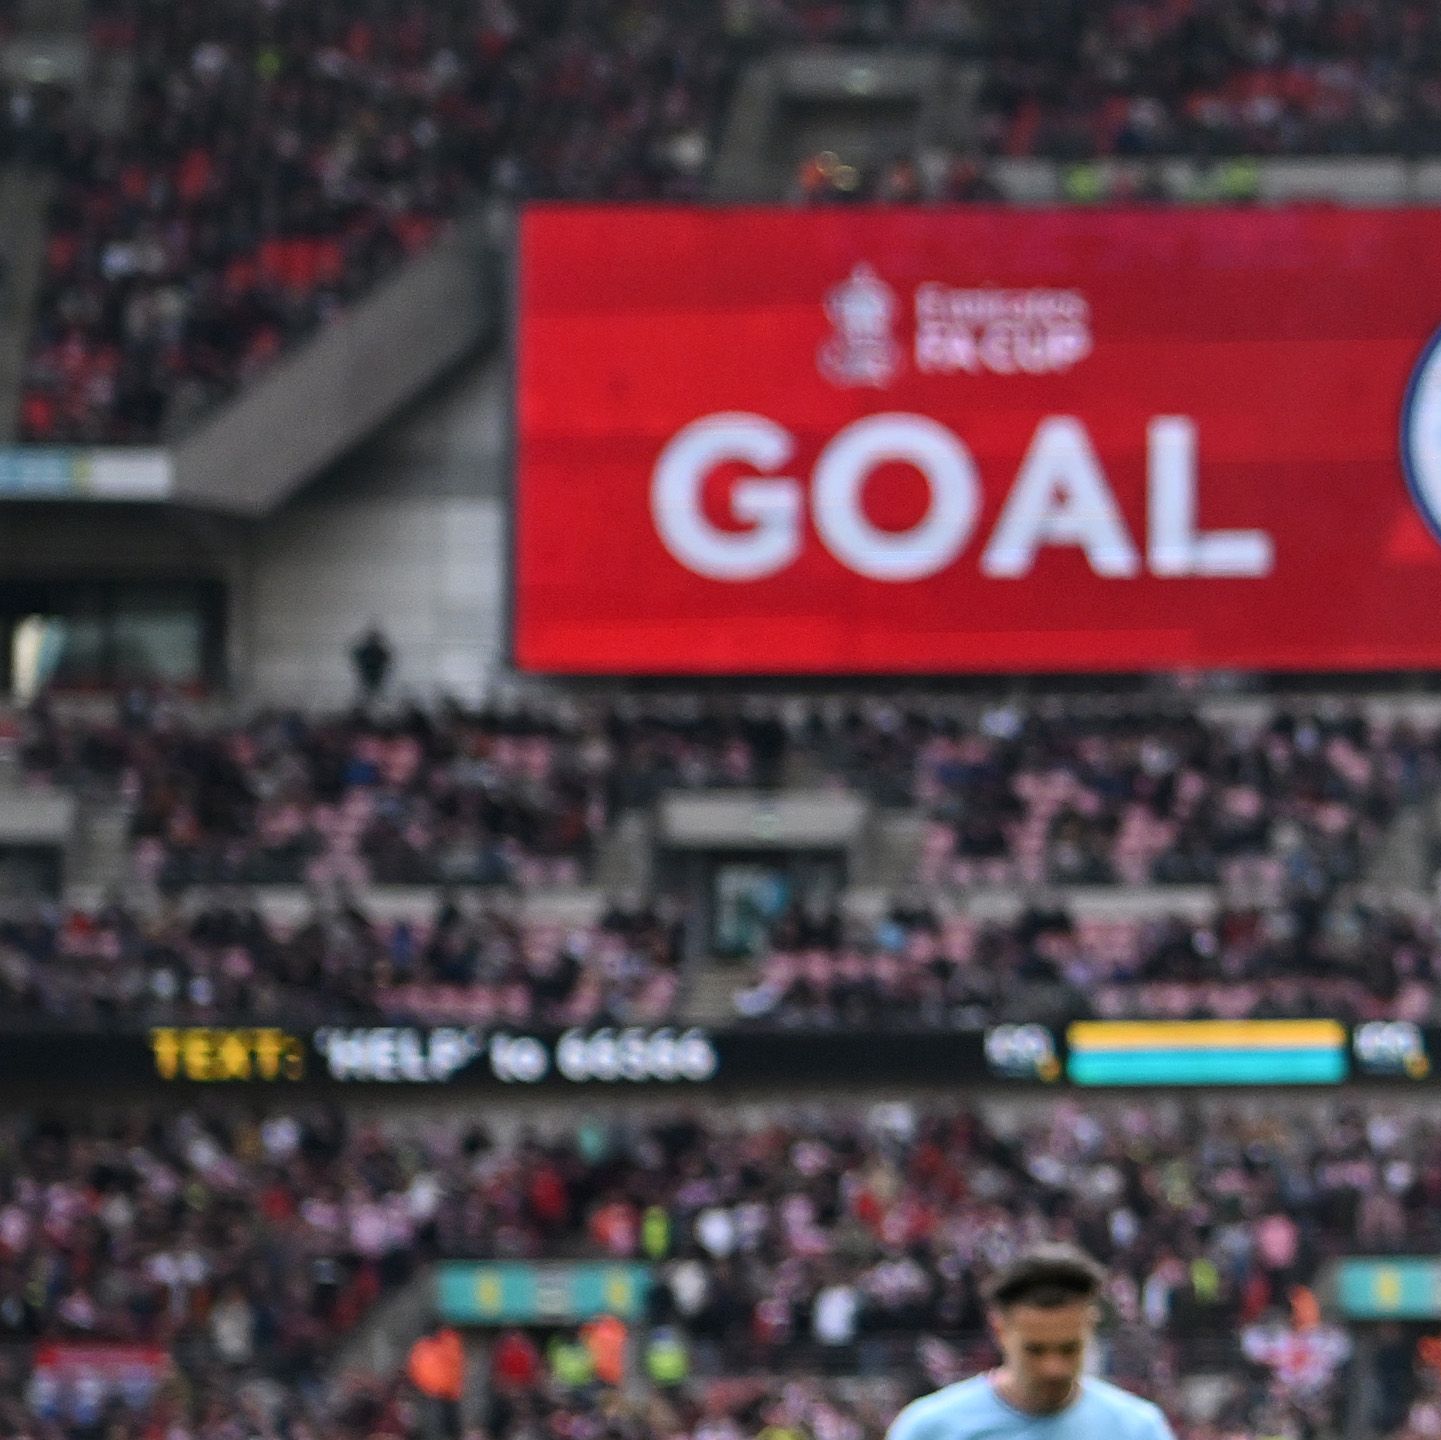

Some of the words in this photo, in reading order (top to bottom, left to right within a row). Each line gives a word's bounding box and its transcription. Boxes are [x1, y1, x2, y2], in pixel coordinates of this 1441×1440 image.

[981, 321, 1092, 375] CUP
[650, 411, 1274, 582] GOAL
[151, 1027, 303, 1081] TEXT:
